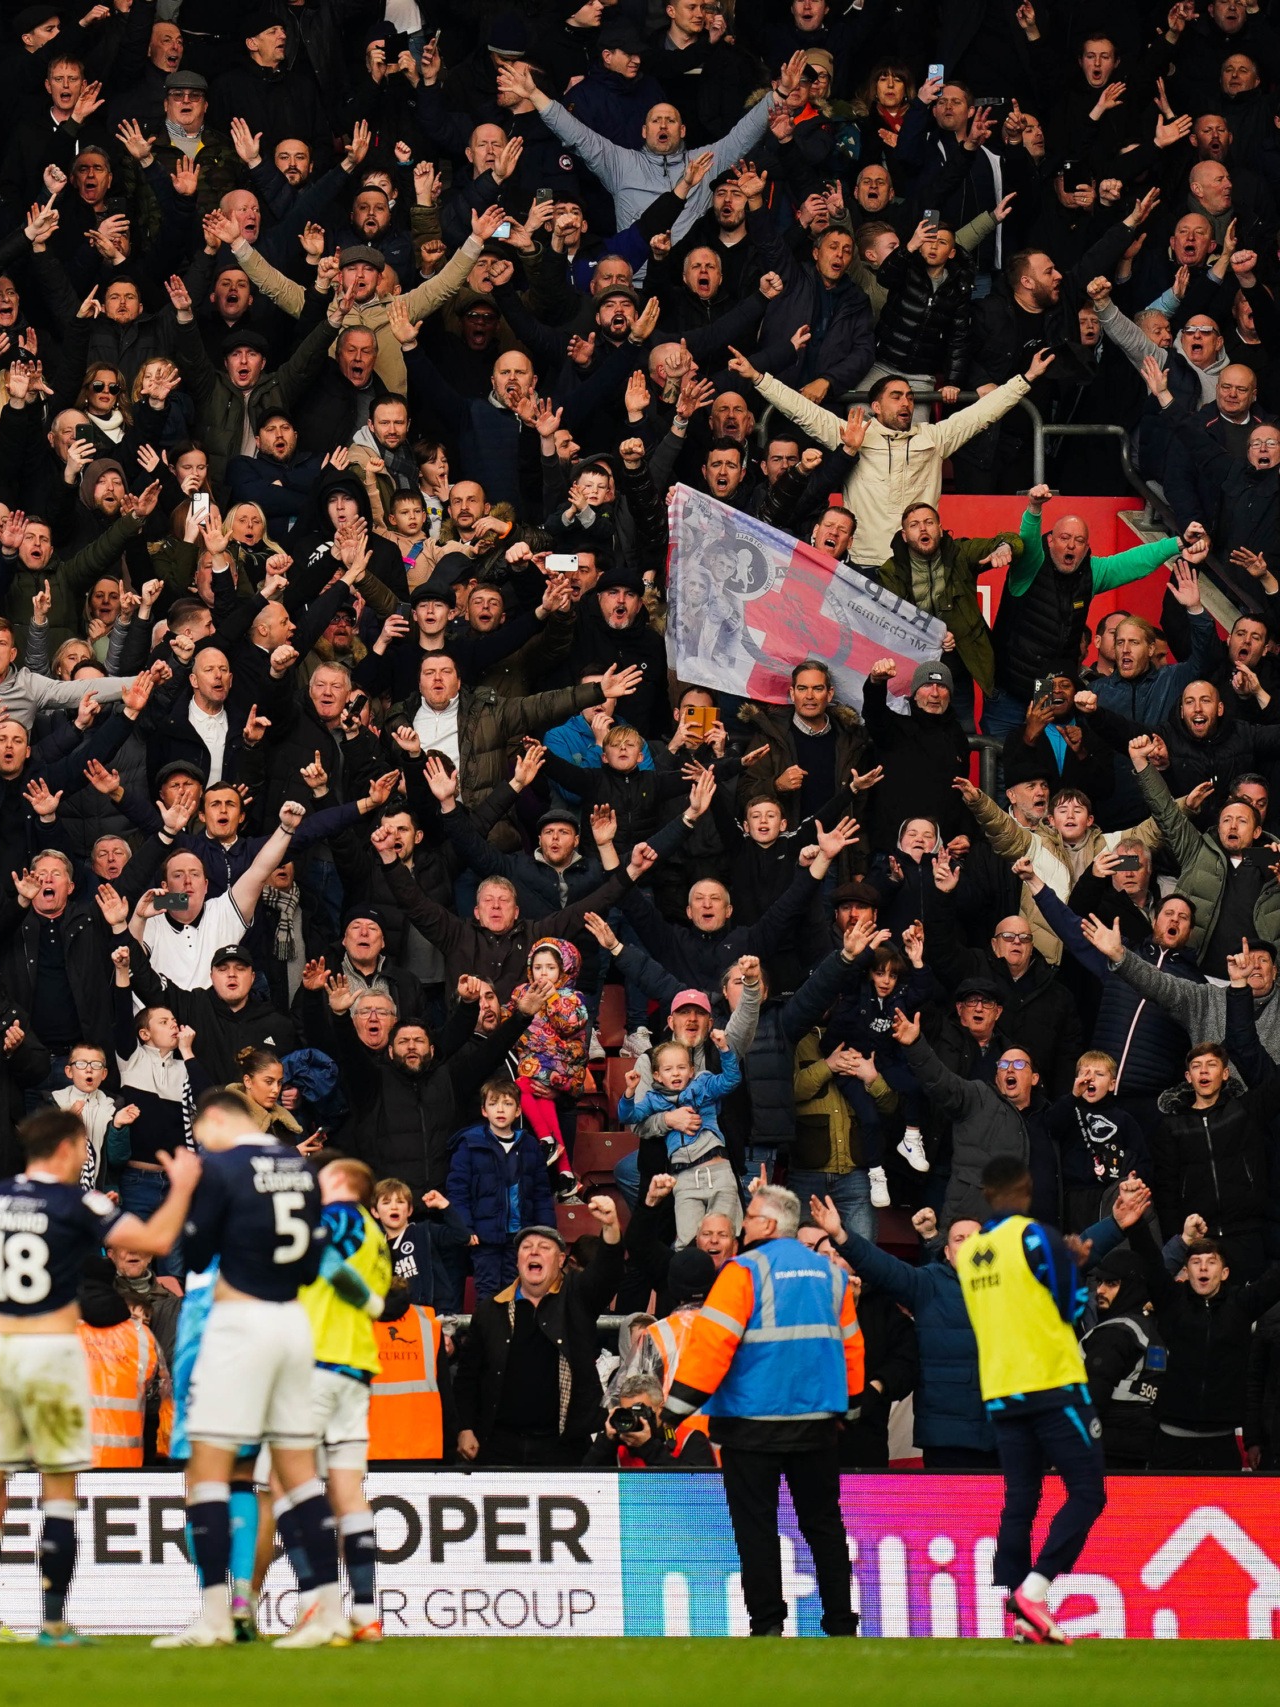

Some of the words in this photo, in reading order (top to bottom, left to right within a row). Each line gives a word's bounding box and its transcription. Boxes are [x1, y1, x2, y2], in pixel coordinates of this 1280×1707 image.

[272, 1191, 310, 1263] 5
[394, 1254, 417, 1276] SKI
[378, 1351, 418, 1361] CURITY
[1139, 1382, 1158, 1400] 506
[0, 1497, 192, 1564] EER
[370, 1494, 593, 1564] OPER
[424, 1588, 596, 1629] GROUP
